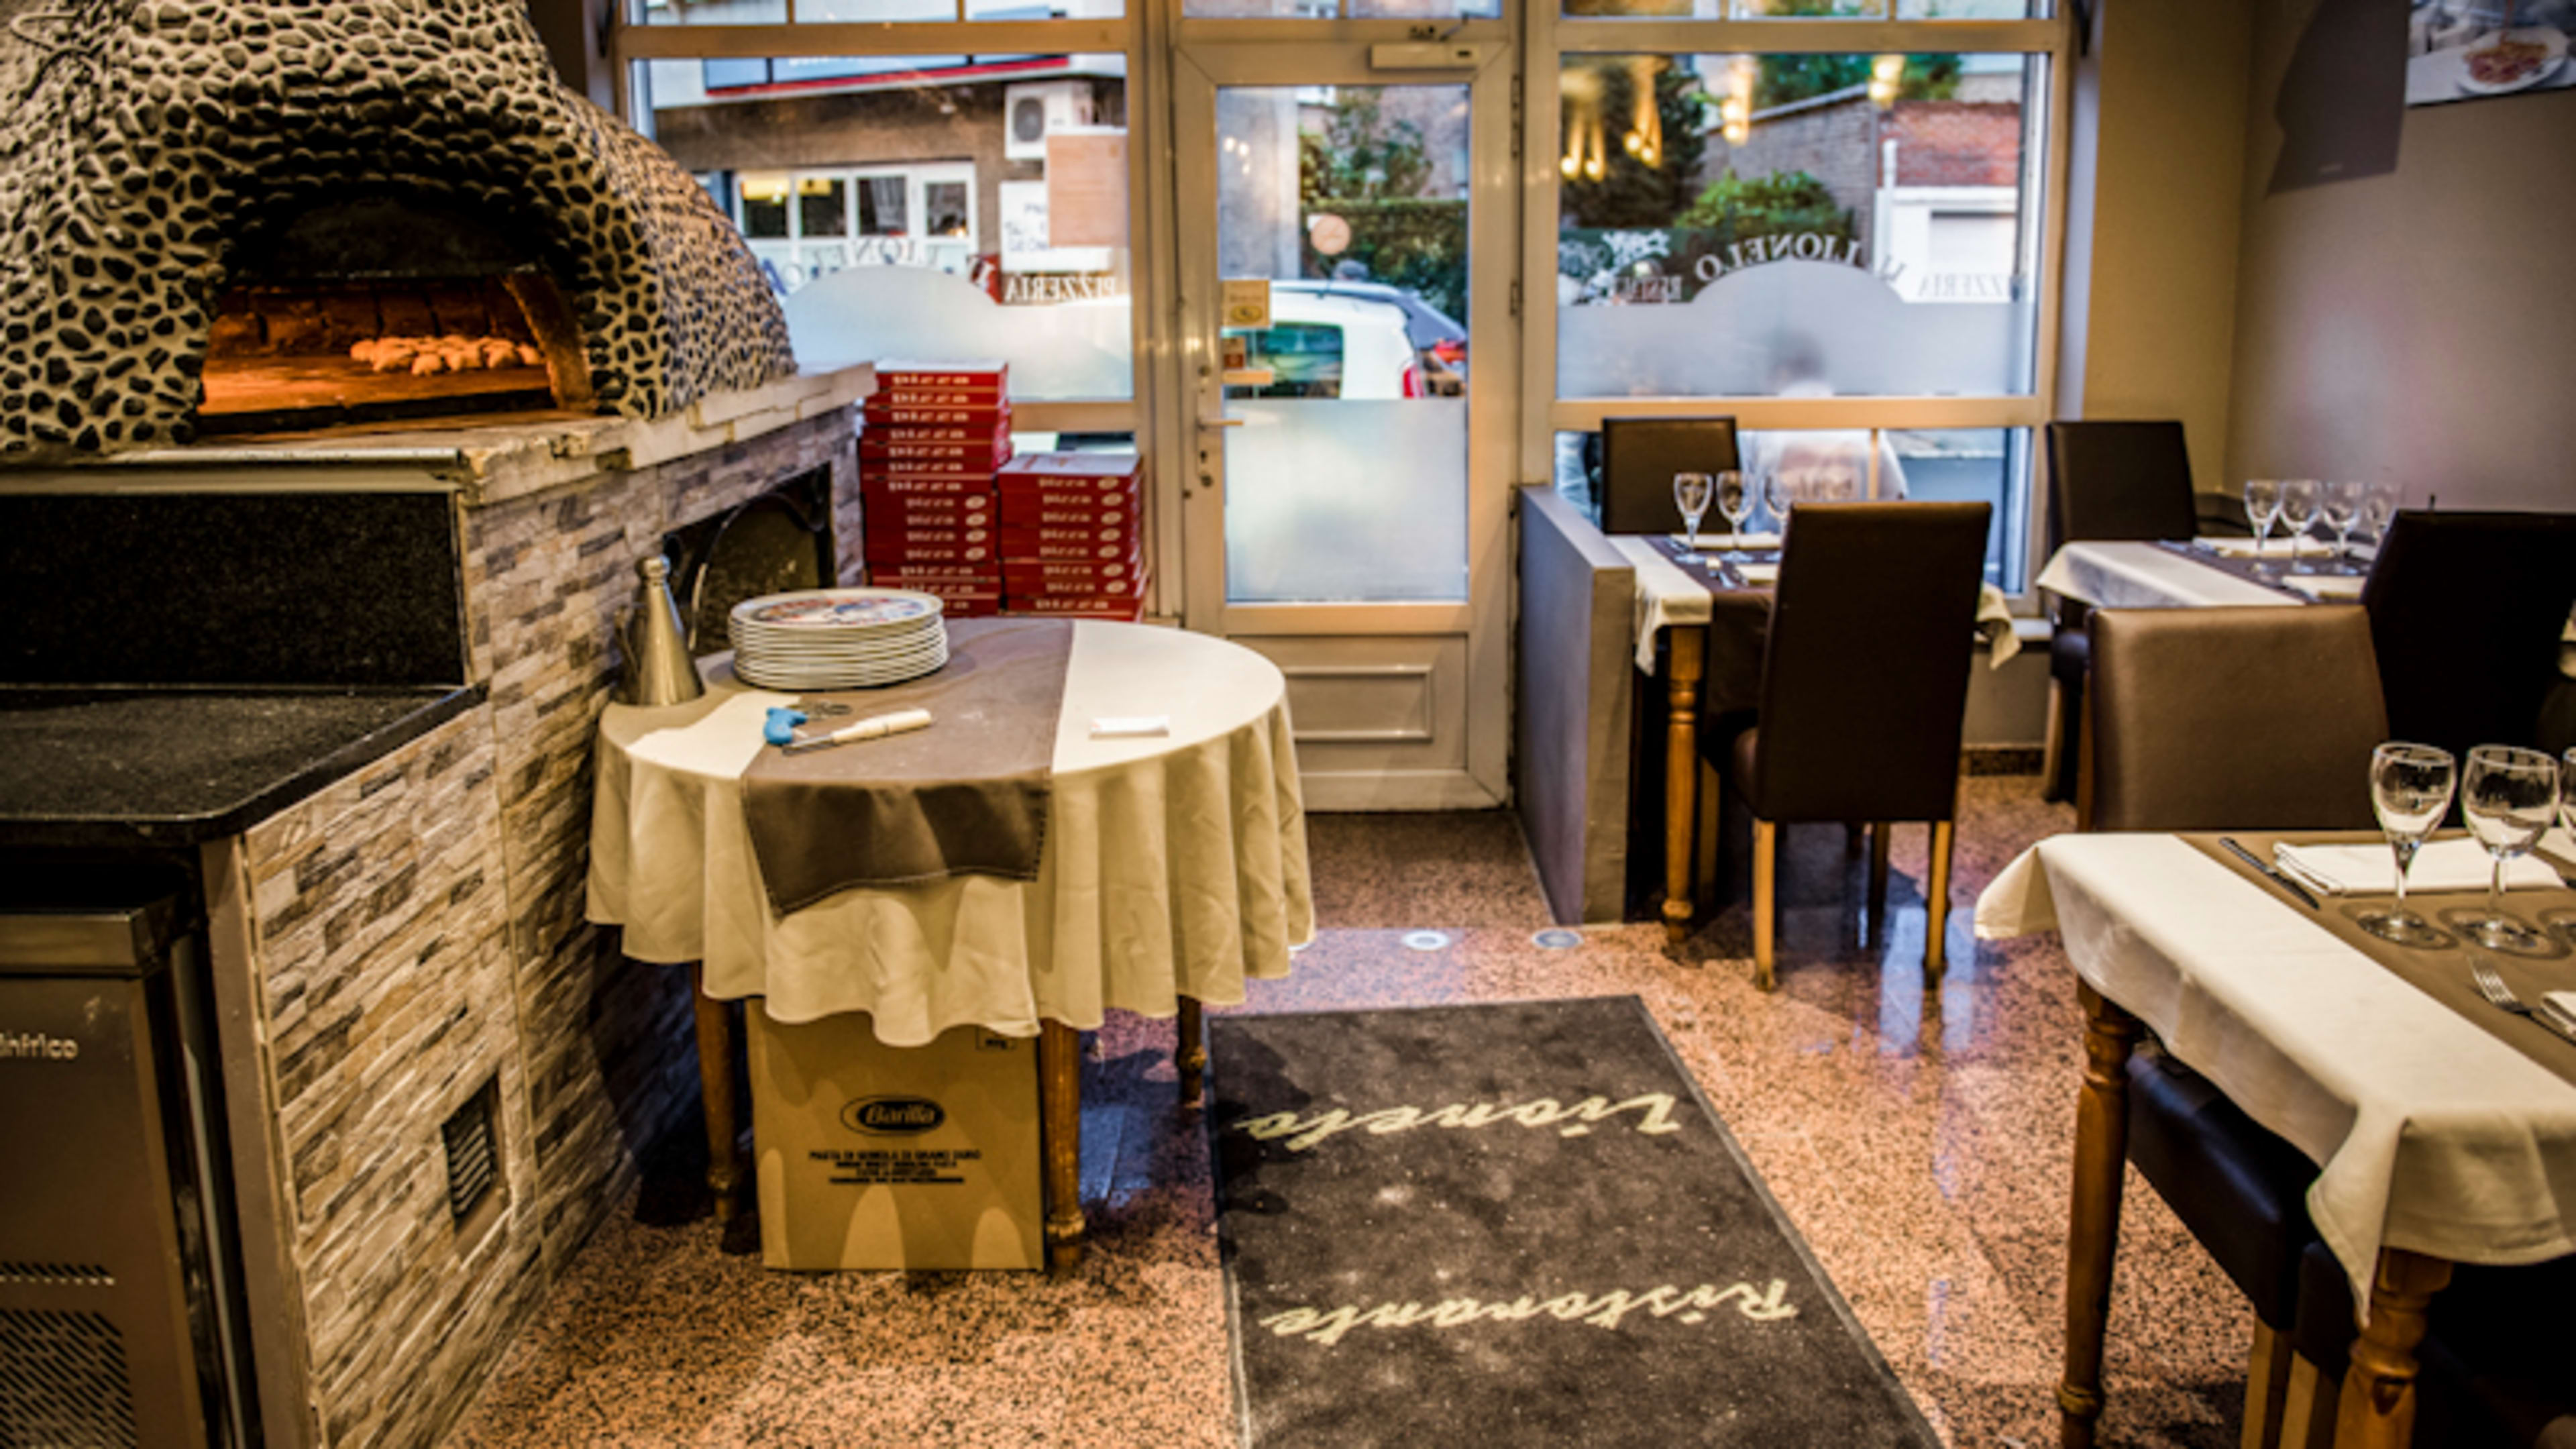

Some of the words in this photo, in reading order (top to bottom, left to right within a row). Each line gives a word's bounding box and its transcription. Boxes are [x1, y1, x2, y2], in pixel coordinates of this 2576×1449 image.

[865, 1105, 936, 1124] Barilla
[1234, 1092, 1681, 1151] Lionelo
[1259, 1277, 1800, 1344] Ristorante
